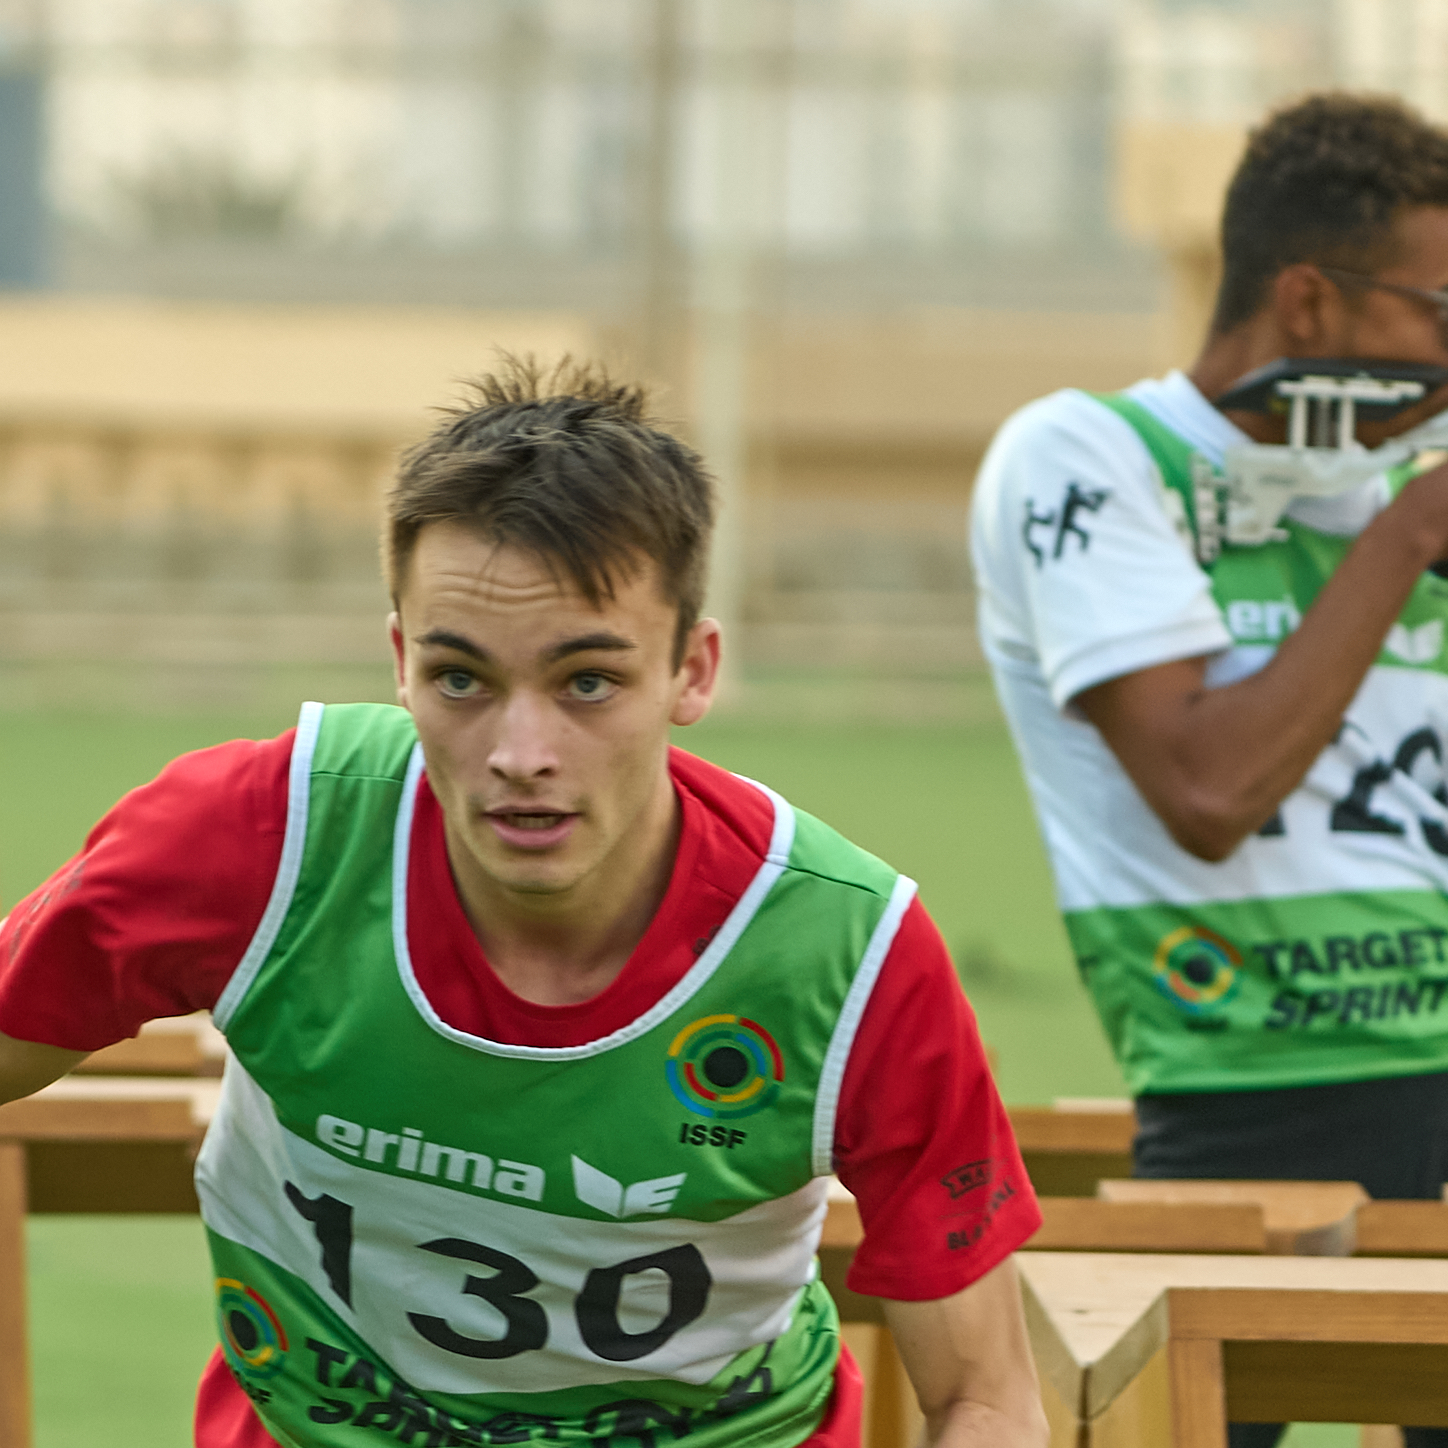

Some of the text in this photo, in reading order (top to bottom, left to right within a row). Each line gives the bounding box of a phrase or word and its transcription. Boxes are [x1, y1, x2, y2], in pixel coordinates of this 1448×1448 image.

[315, 1113, 546, 1202] erima
[679, 1122, 747, 1149] ISSF
[284, 1180, 712, 1362] 130
